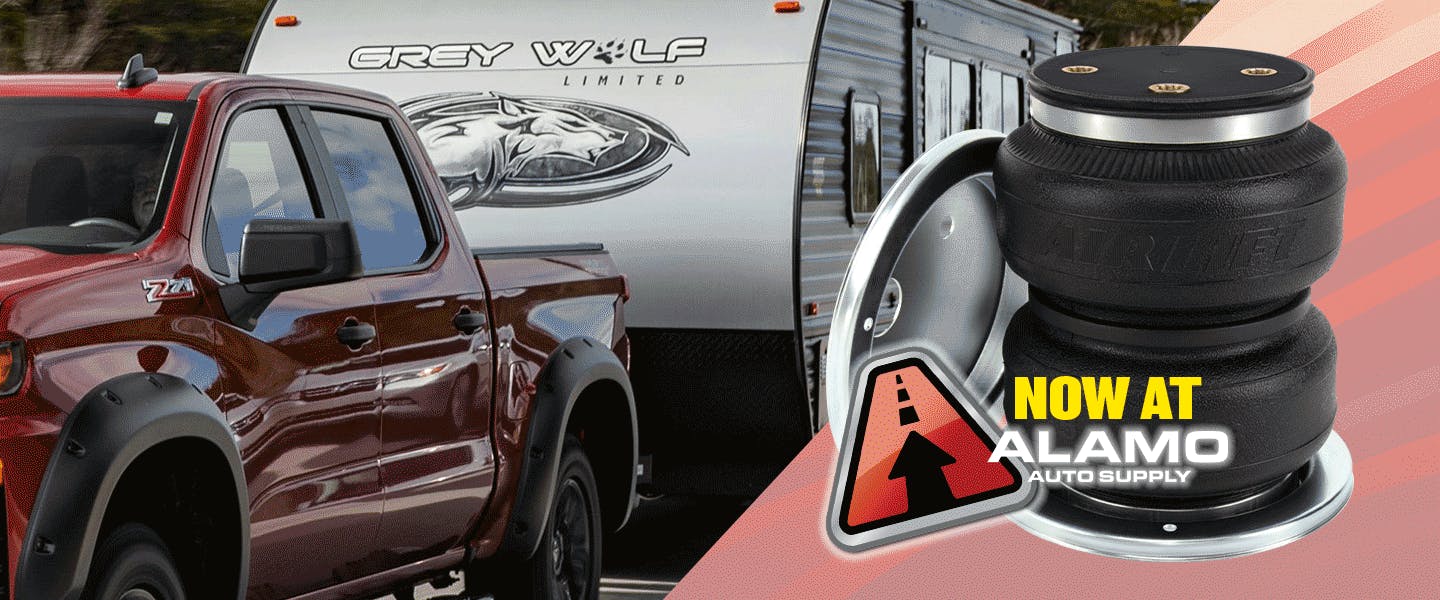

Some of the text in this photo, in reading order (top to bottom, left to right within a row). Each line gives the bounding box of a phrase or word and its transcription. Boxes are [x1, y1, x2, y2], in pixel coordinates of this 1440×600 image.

[348, 42, 513, 70] GREY
[563, 74, 686, 87] LIMITED
[142, 277, 196, 303] Z71
